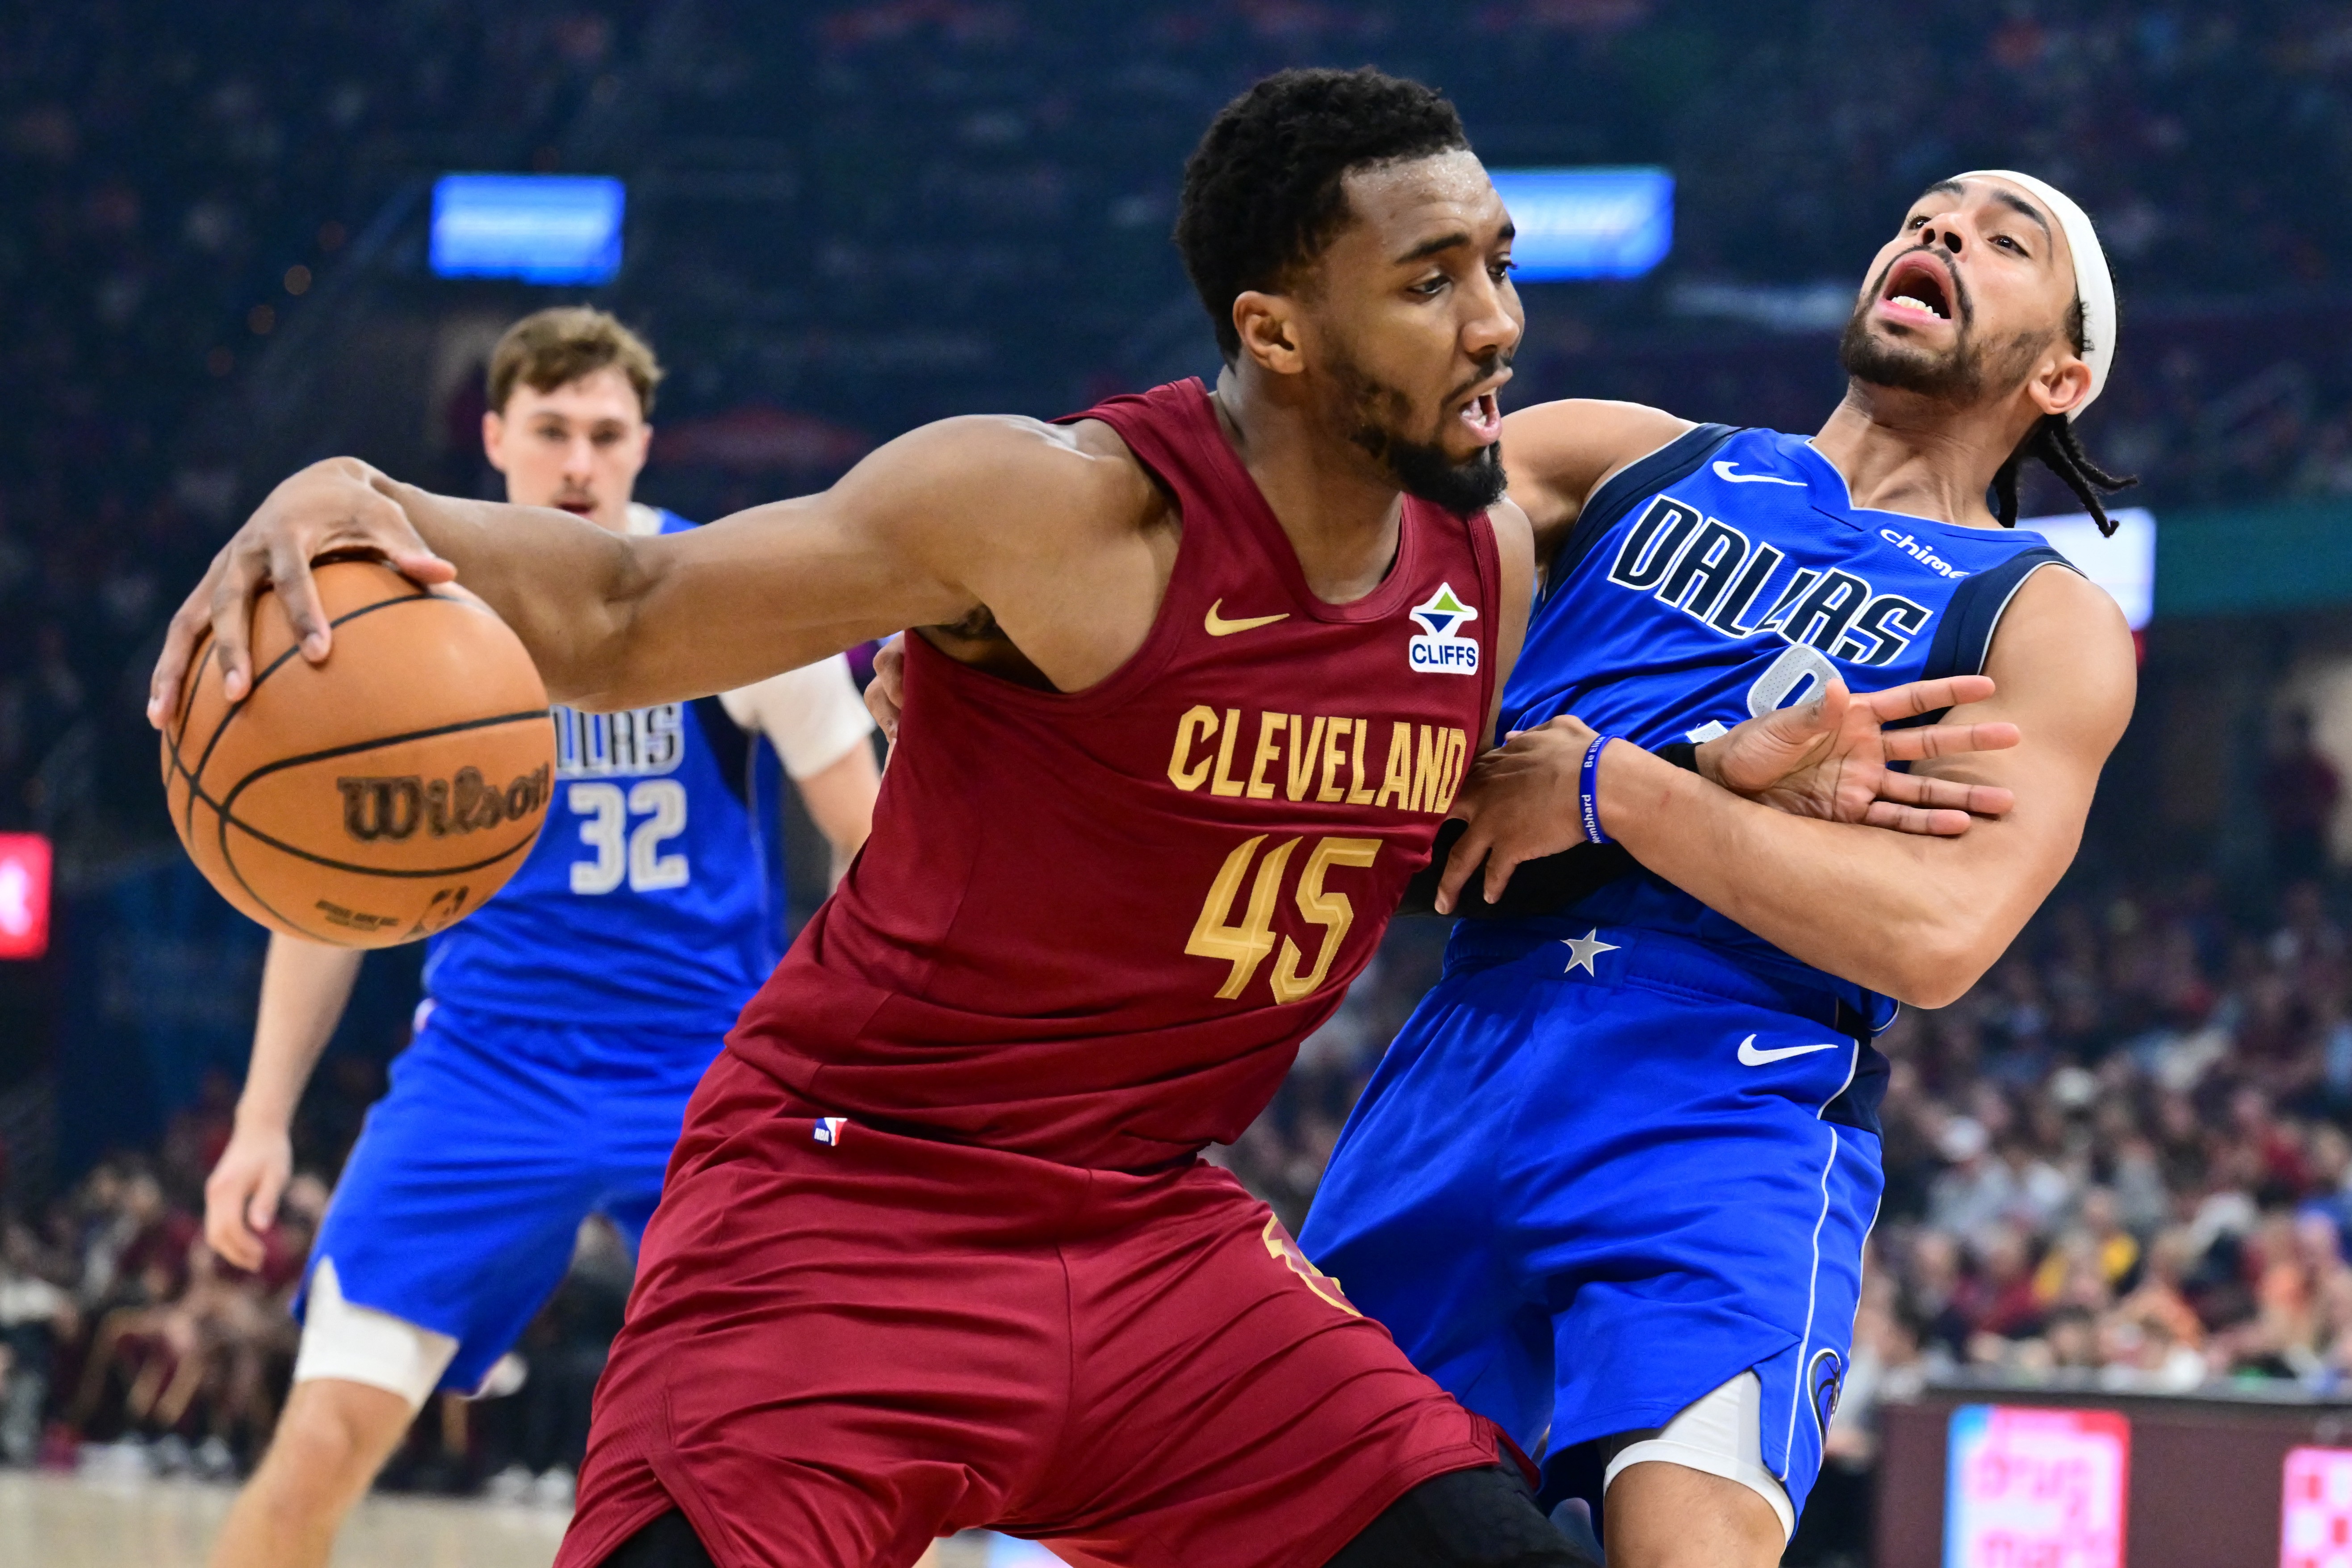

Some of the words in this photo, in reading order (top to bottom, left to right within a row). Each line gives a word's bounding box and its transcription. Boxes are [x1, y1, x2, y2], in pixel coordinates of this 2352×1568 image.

[1607, 494, 1933, 666] DALLAS
[1880, 529, 1971, 578] chime
[1412, 644, 1476, 667] CLIFFS
[549, 703, 685, 780] LLAS
[1168, 705, 1467, 814] CLEVELAND
[337, 761, 549, 843] Wilson
[568, 778, 691, 895] 32
[1184, 834, 1383, 1005] 45
[814, 1128, 830, 1142] NBA
